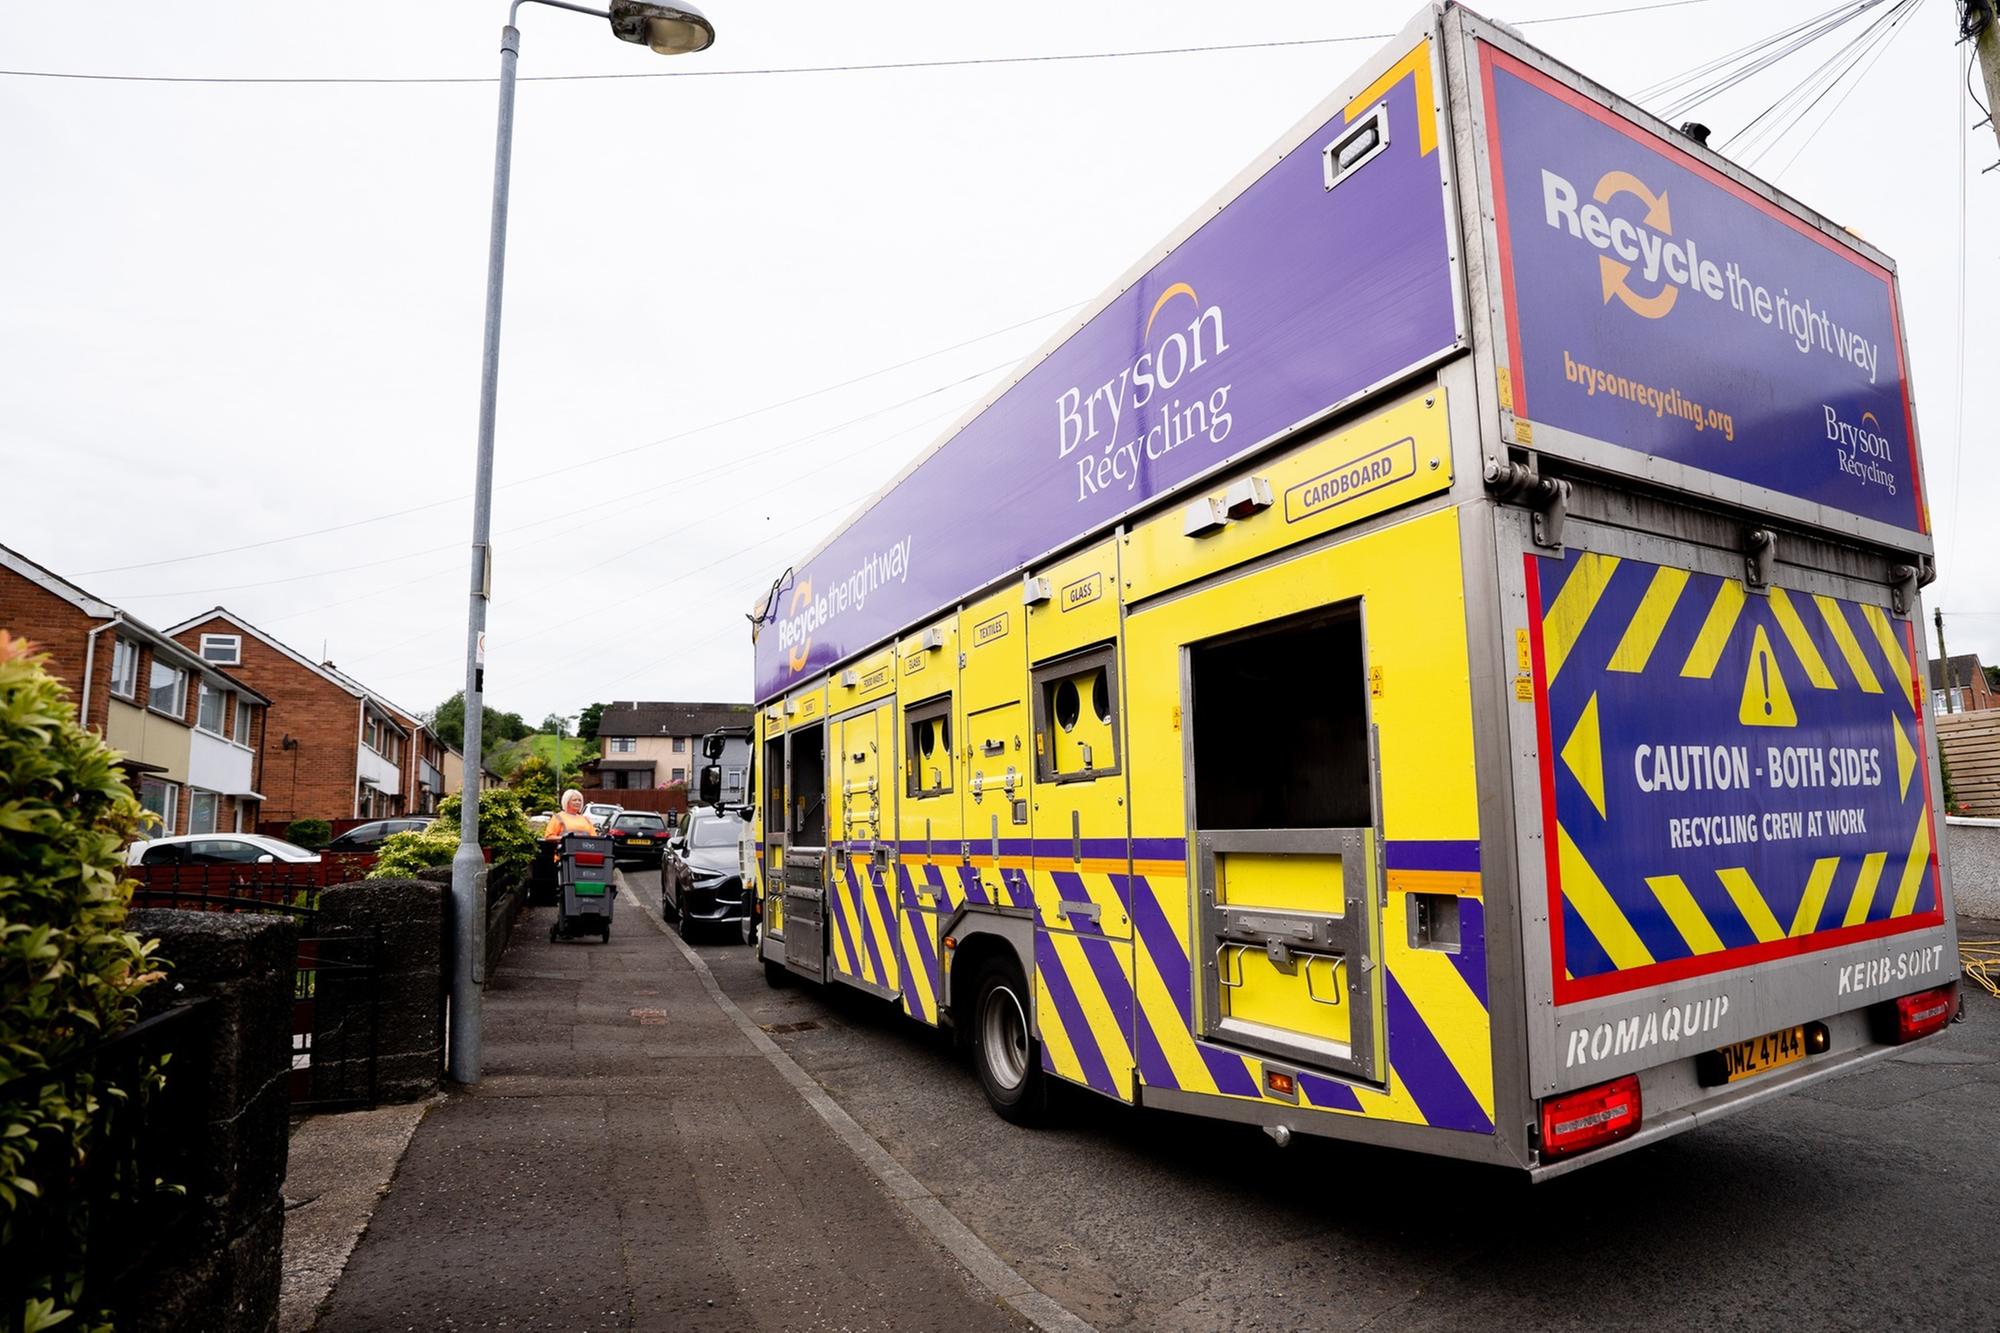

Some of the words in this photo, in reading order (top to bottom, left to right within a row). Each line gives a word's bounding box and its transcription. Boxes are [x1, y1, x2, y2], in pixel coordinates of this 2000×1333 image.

[1541, 168, 1724, 300] Recycle
[1055, 303, 1230, 459] Bryson
[1563, 351, 1735, 441] brysonrecycling.org
[1077, 384, 1232, 502] Recycling
[1822, 404, 1893, 462] Bryson
[1303, 457, 1393, 507] CARDBOARD
[1837, 448, 1896, 496] Recycling
[1070, 583, 1092, 603] GLASS
[779, 594, 828, 652] Recycle
[979, 622, 1002, 639] TEXTILES
[908, 657, 921, 669] GLASS
[1634, 744, 1750, 792] CAUTION
[1767, 746, 1826, 788] BOTH
[1829, 747, 1882, 787] SIDES
[1669, 813, 1759, 849] RECYCLING
[1762, 811, 1803, 842] CREW
[1807, 810, 1823, 838] AT
[1826, 808, 1867, 836] WORK
[1838, 944, 1943, 996] KERB-SORT
[1566, 995, 1730, 1068] ROMAQUIP
[1760, 1027, 1799, 1065] 4744
